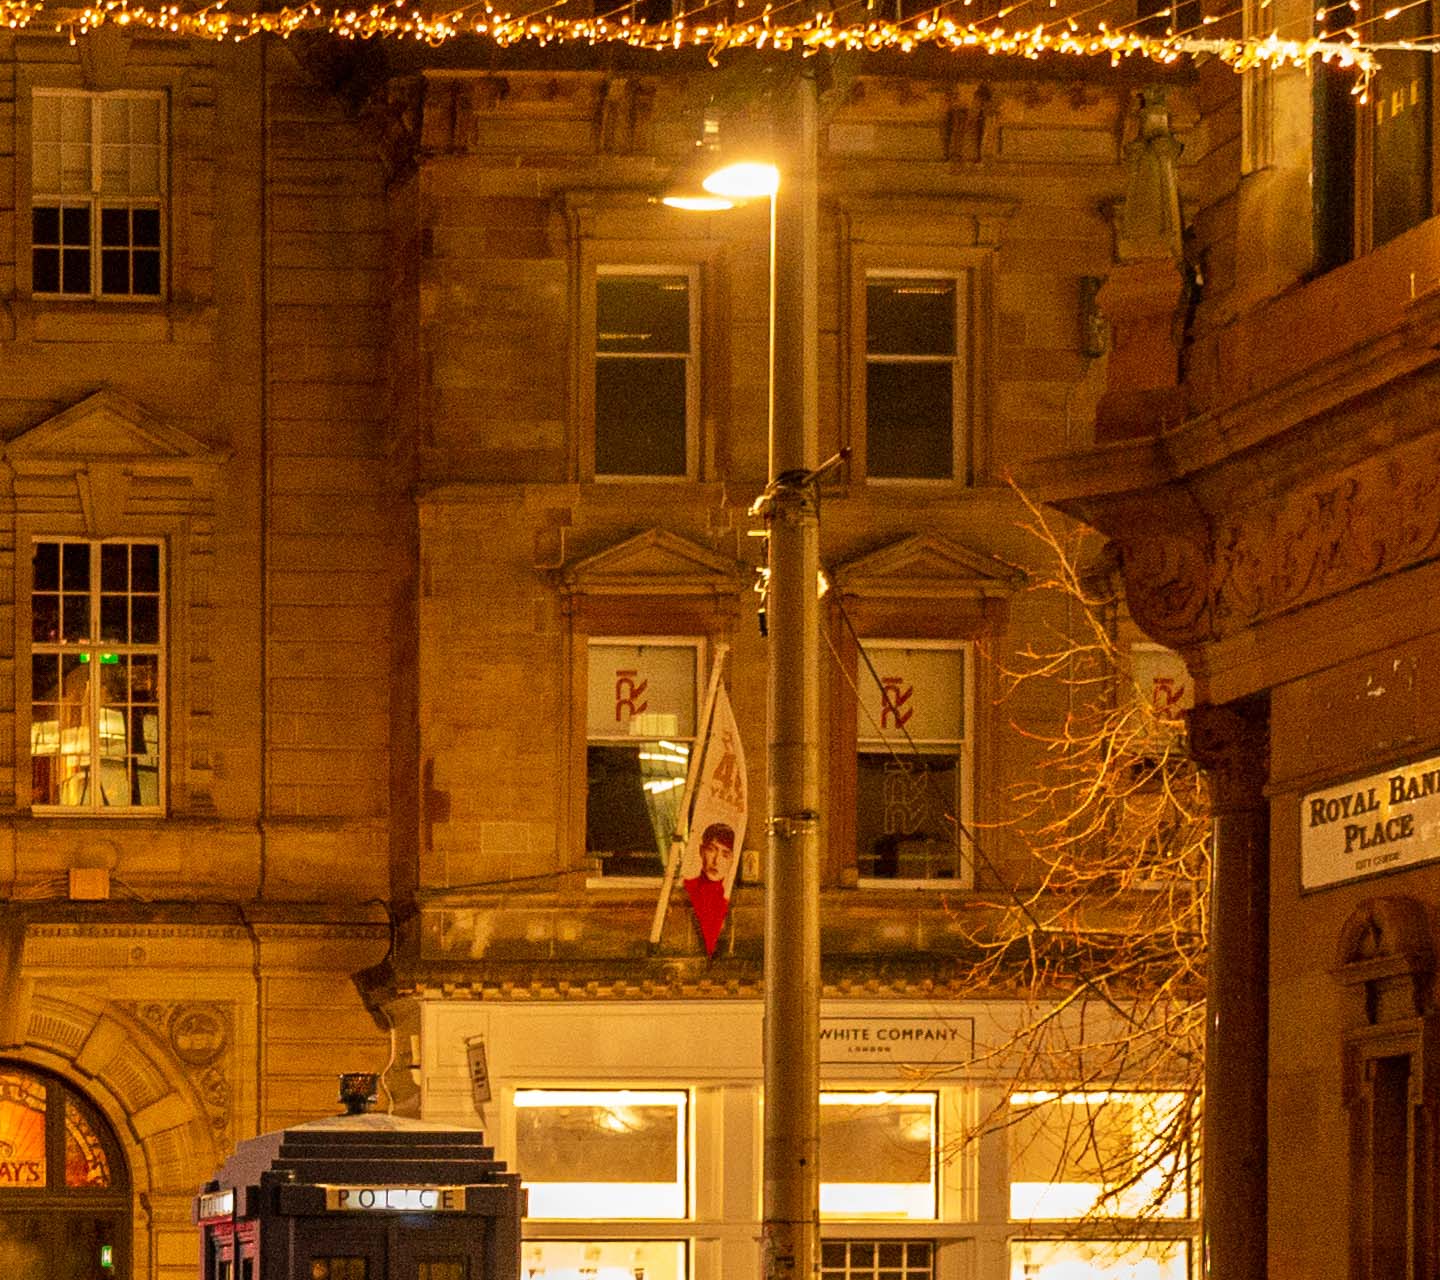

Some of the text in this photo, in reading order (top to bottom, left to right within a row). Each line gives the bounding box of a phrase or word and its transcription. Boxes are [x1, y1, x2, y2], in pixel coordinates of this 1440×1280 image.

[1310, 789, 1379, 827] ROYAL
[1344, 815, 1413, 853] PLACE
[876, 1028, 958, 1041] COMPANY
